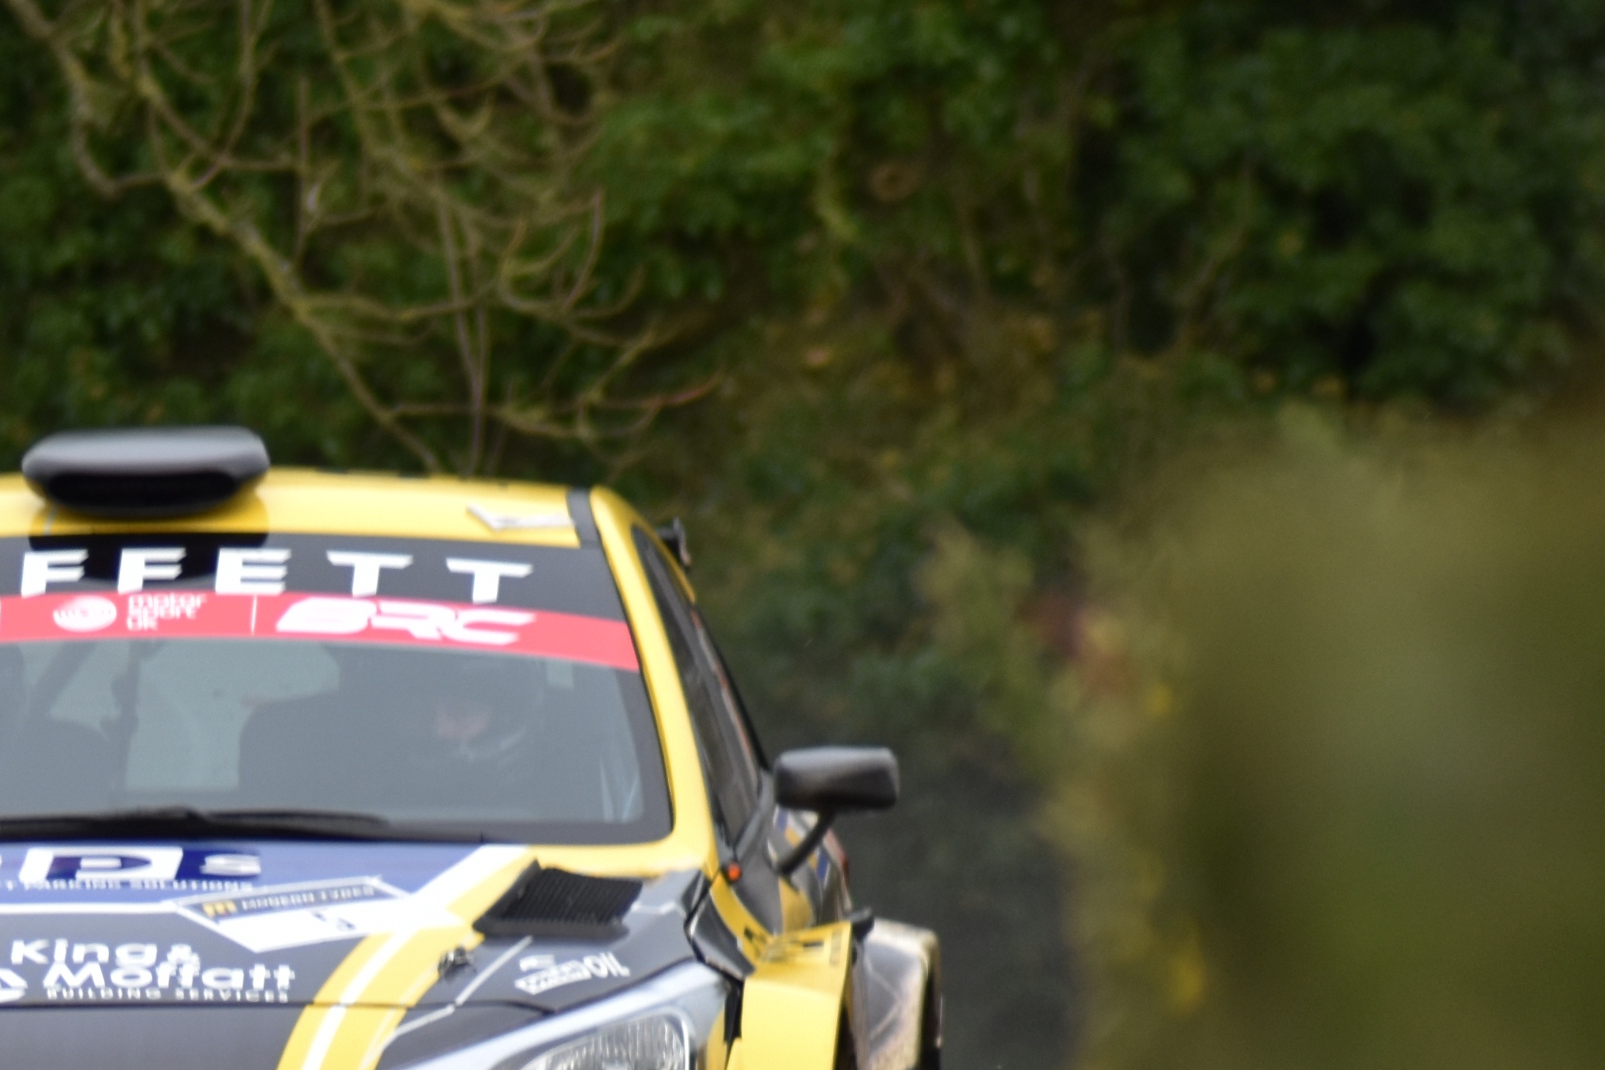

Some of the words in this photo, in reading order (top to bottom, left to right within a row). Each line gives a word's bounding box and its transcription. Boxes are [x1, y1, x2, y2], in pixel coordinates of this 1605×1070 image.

[43, 960, 296, 991] Moffatt
[46, 986, 162, 1001] BUILDING
[174, 987, 289, 1003] SERVICES
